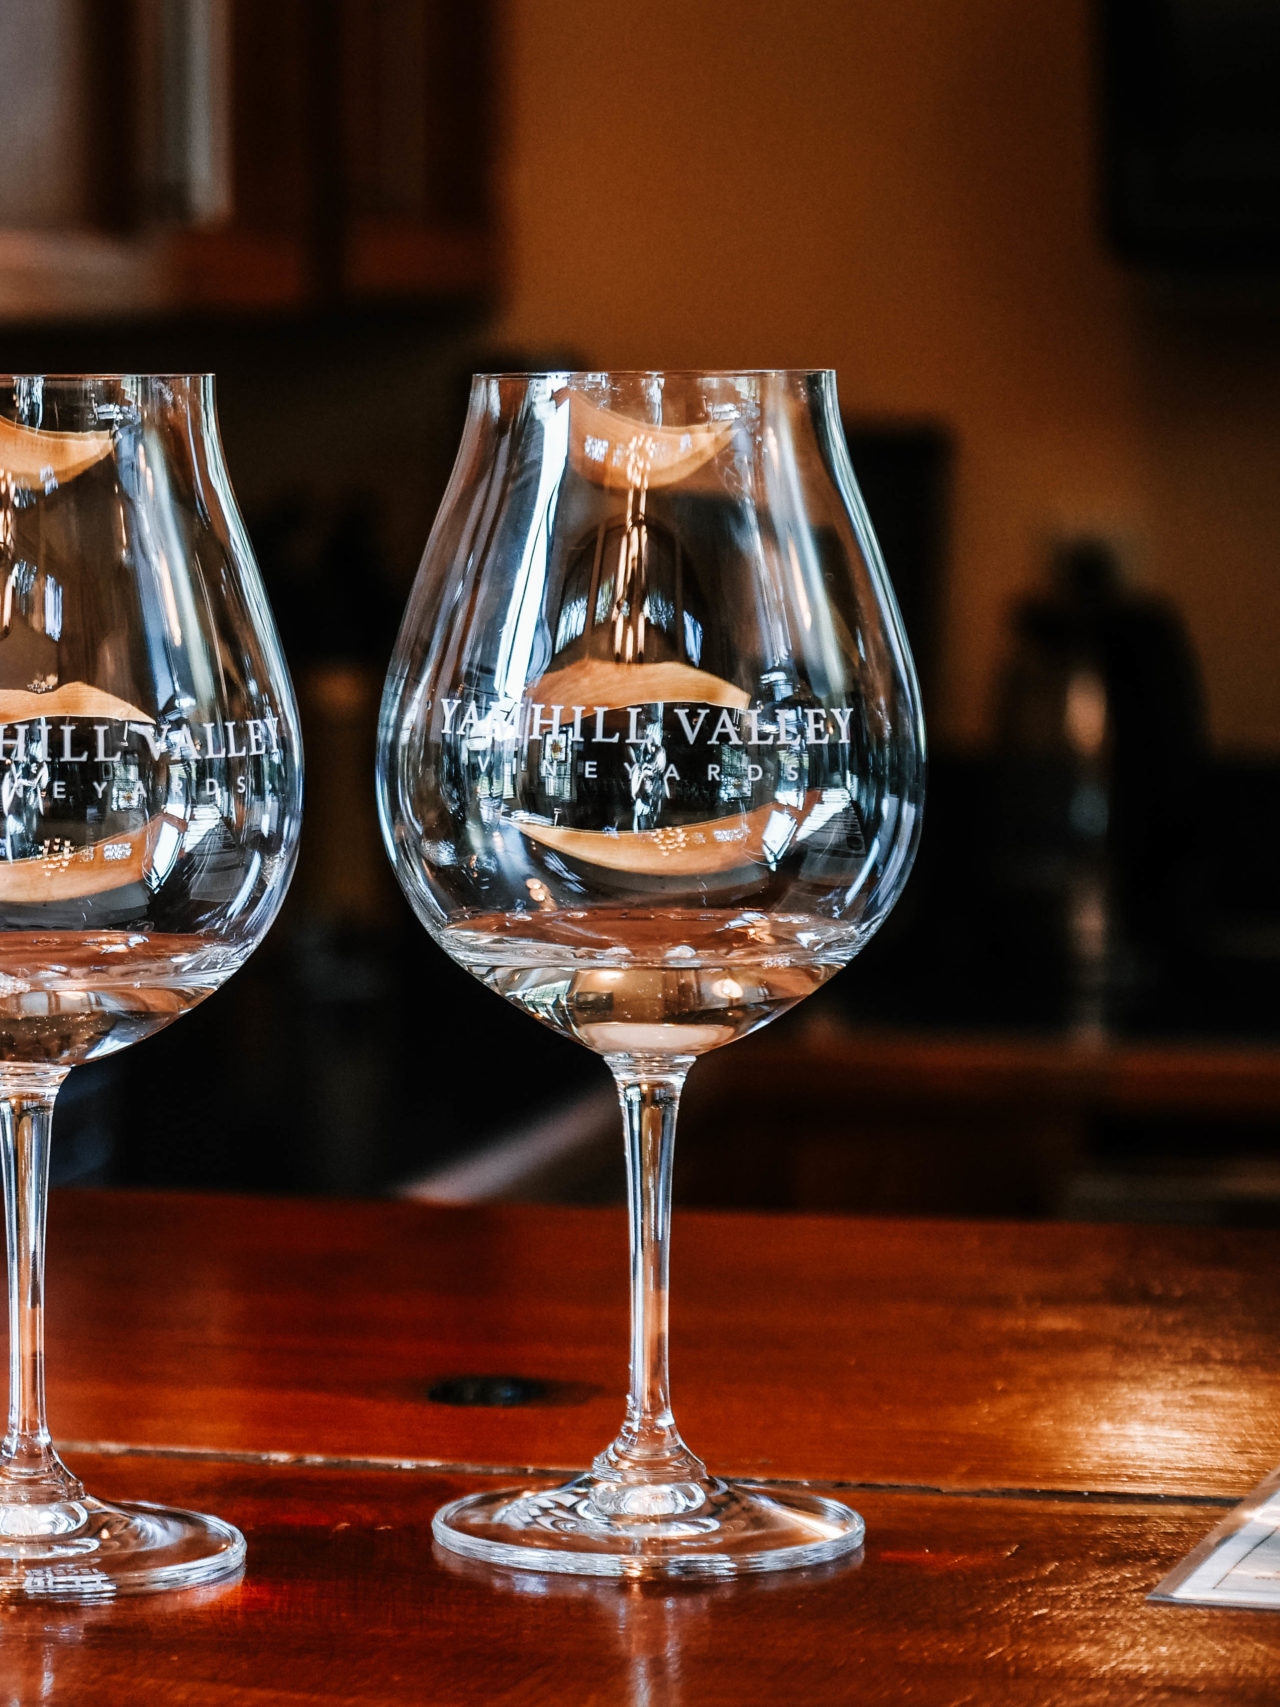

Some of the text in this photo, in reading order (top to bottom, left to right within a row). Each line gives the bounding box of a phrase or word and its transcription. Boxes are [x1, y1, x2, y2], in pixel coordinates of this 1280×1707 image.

[140, 717, 280, 762] VALLEY
[440, 698, 854, 745] YAMHILL VALLEY
